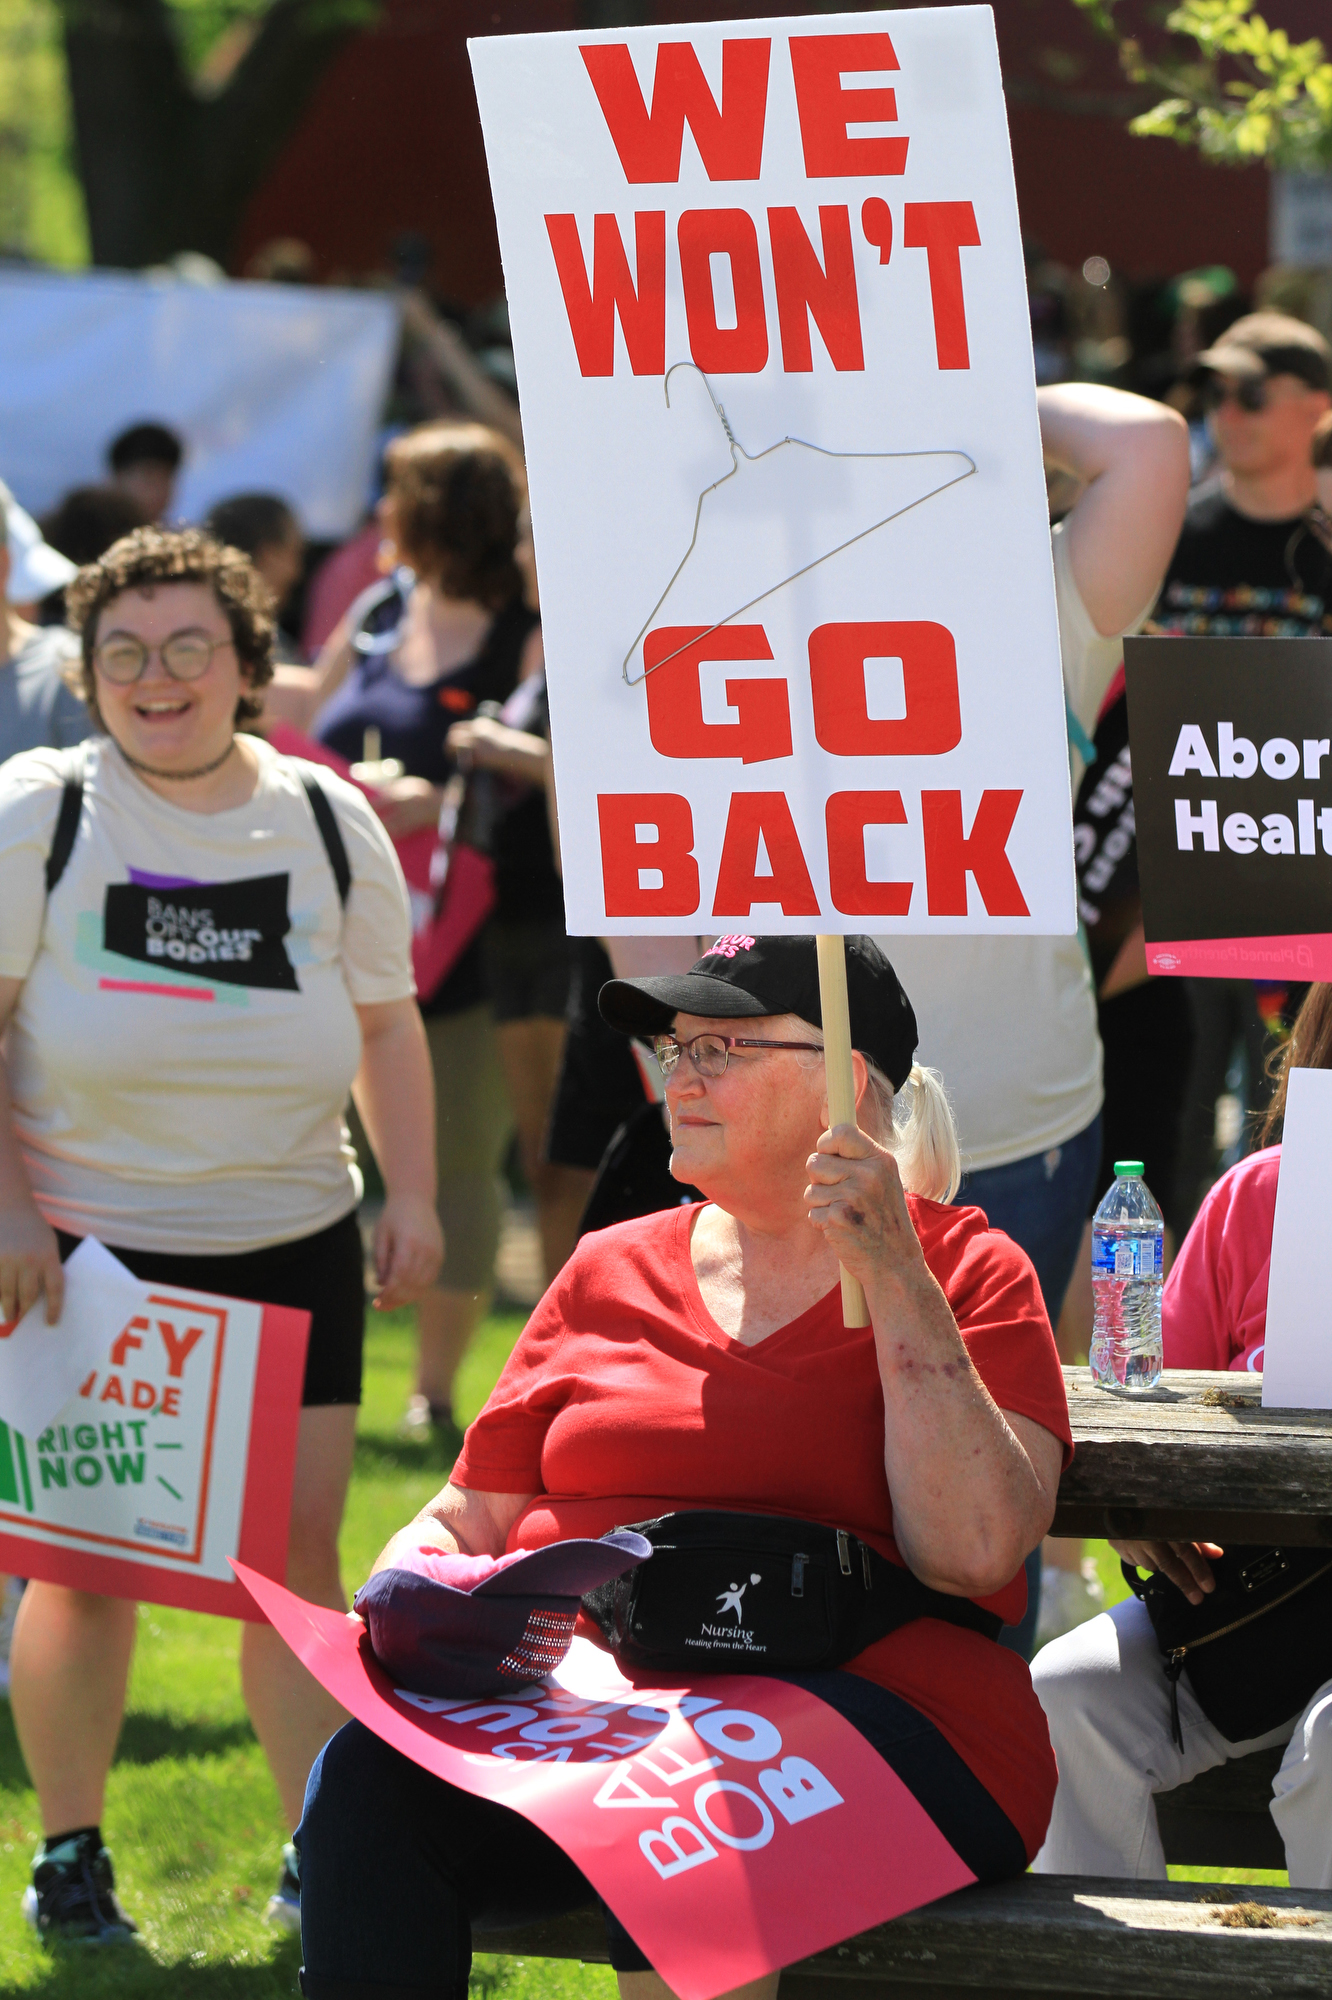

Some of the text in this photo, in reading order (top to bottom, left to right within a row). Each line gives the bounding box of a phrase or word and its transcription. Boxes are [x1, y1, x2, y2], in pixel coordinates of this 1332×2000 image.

[578, 32, 910, 185] WE
[543, 196, 982, 377] WON'T
[642, 620, 962, 765] GO
[596, 788, 1032, 918] BACK
[147, 896, 215, 930] BANS
[146, 936, 252, 964] BODIES
[37, 1419, 147, 1454] RIGHT
[38, 1452, 145, 1489] NOW
[684, 1637, 767, 1653] Healing from the Heart
[701, 1622, 755, 1644] Nursing
